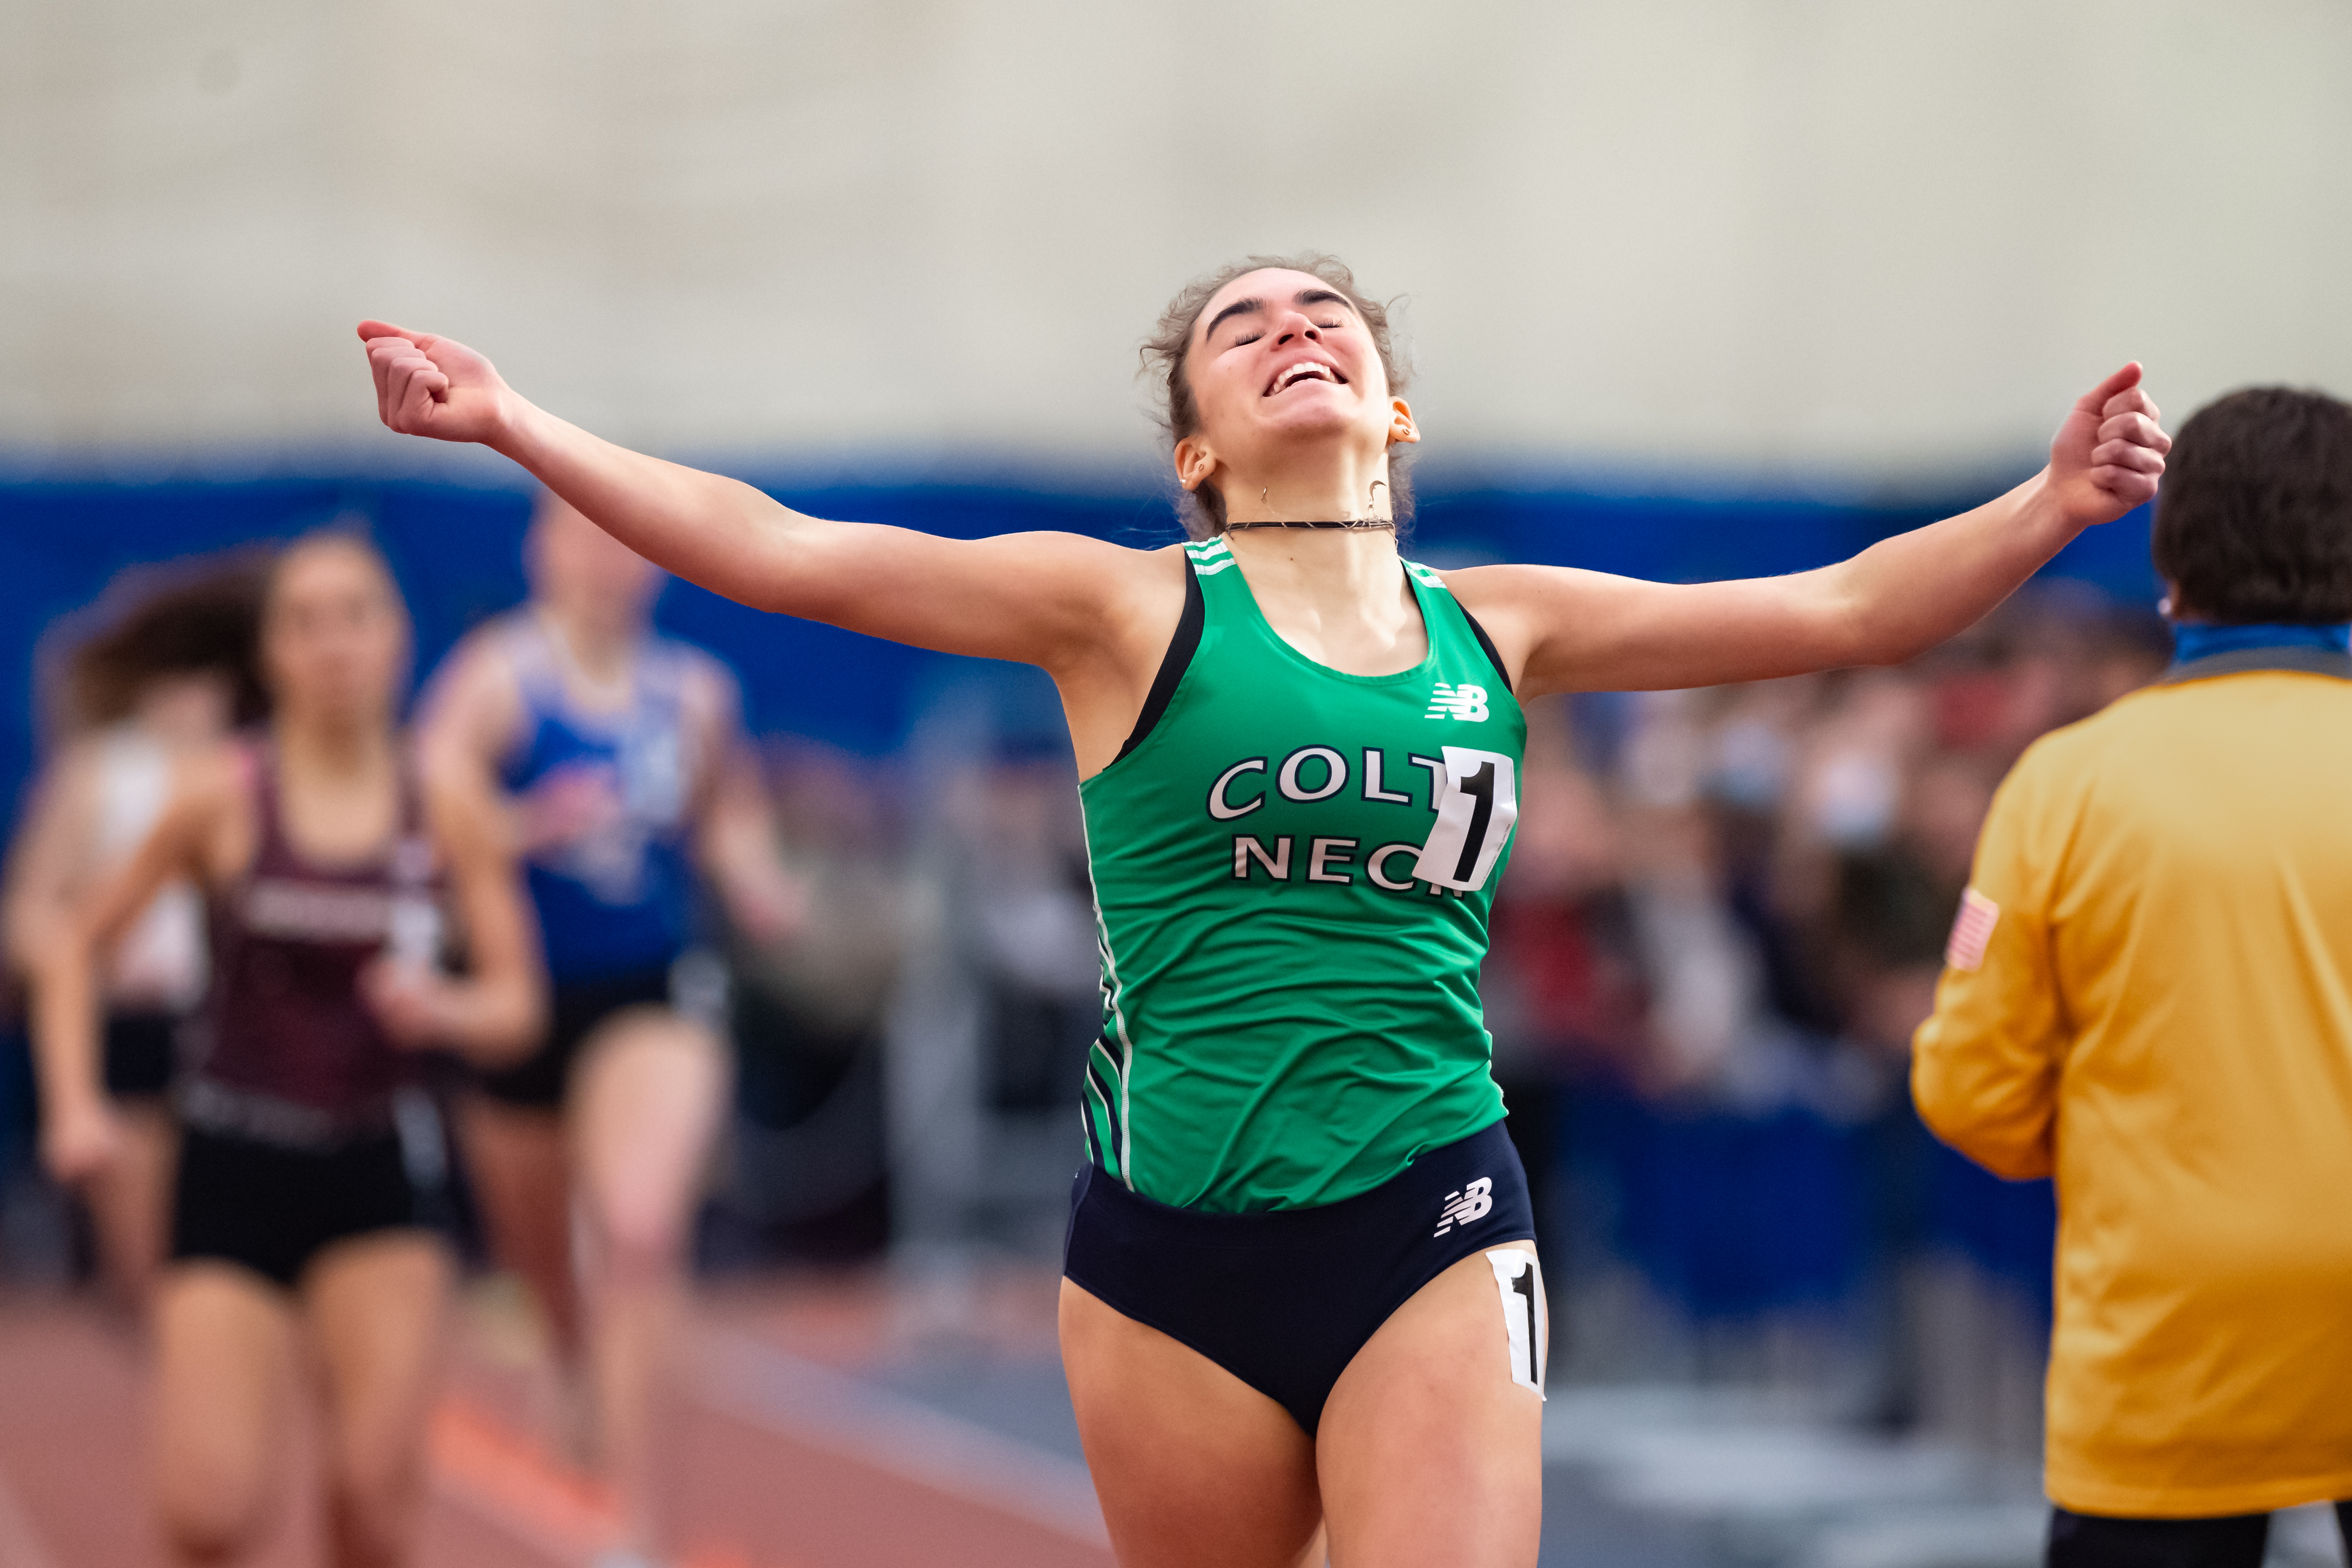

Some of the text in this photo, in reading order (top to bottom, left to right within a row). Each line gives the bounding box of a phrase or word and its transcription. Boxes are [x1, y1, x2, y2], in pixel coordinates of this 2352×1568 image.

[1424, 682, 1489, 722] NB
[1453, 761, 1495, 883] 1
[1231, 834, 1465, 900] NEC
[1433, 1177, 1492, 1238] NB
[1511, 1262, 1538, 1386] 1
